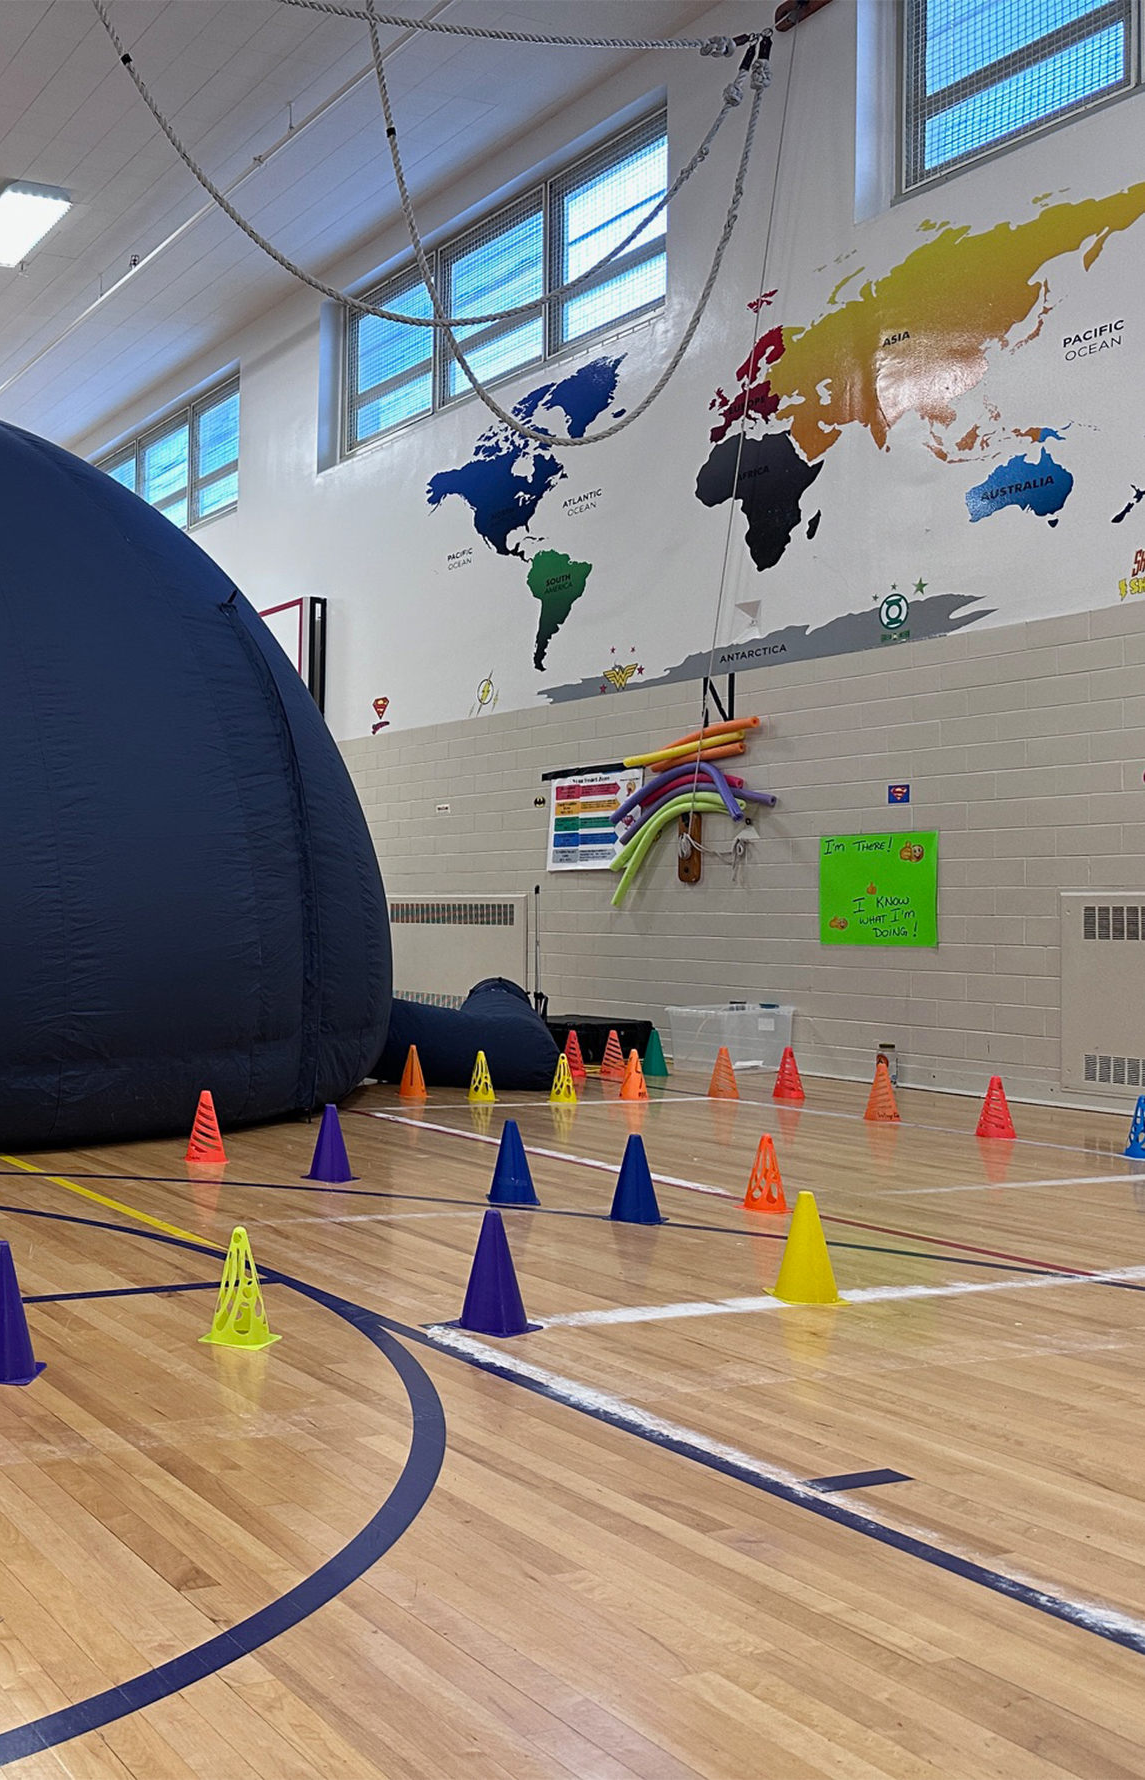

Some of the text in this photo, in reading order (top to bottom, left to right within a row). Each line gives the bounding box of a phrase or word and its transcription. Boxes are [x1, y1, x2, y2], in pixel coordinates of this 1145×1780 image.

[882, 331, 911, 347] ASIA
[1062, 320, 1125, 348] PACIFIC
[1064, 335, 1122, 361] OCEAN
[980, 475, 1055, 502] AUSTRALIA
[562, 488, 603, 509] ATLANTIC
[567, 501, 597, 517] OCEAN
[447, 547, 473, 562] PACIFIC
[448, 557, 472, 571] OCEAN
[543, 582, 573, 595] AMERICA
[545, 573, 571, 588] SOUTH
[719, 643, 787, 664] ANTARCTICA
[824, 839, 845, 855] I'm
[853, 896, 909, 914] I KNOW
[859, 914, 887, 925] WHAT
